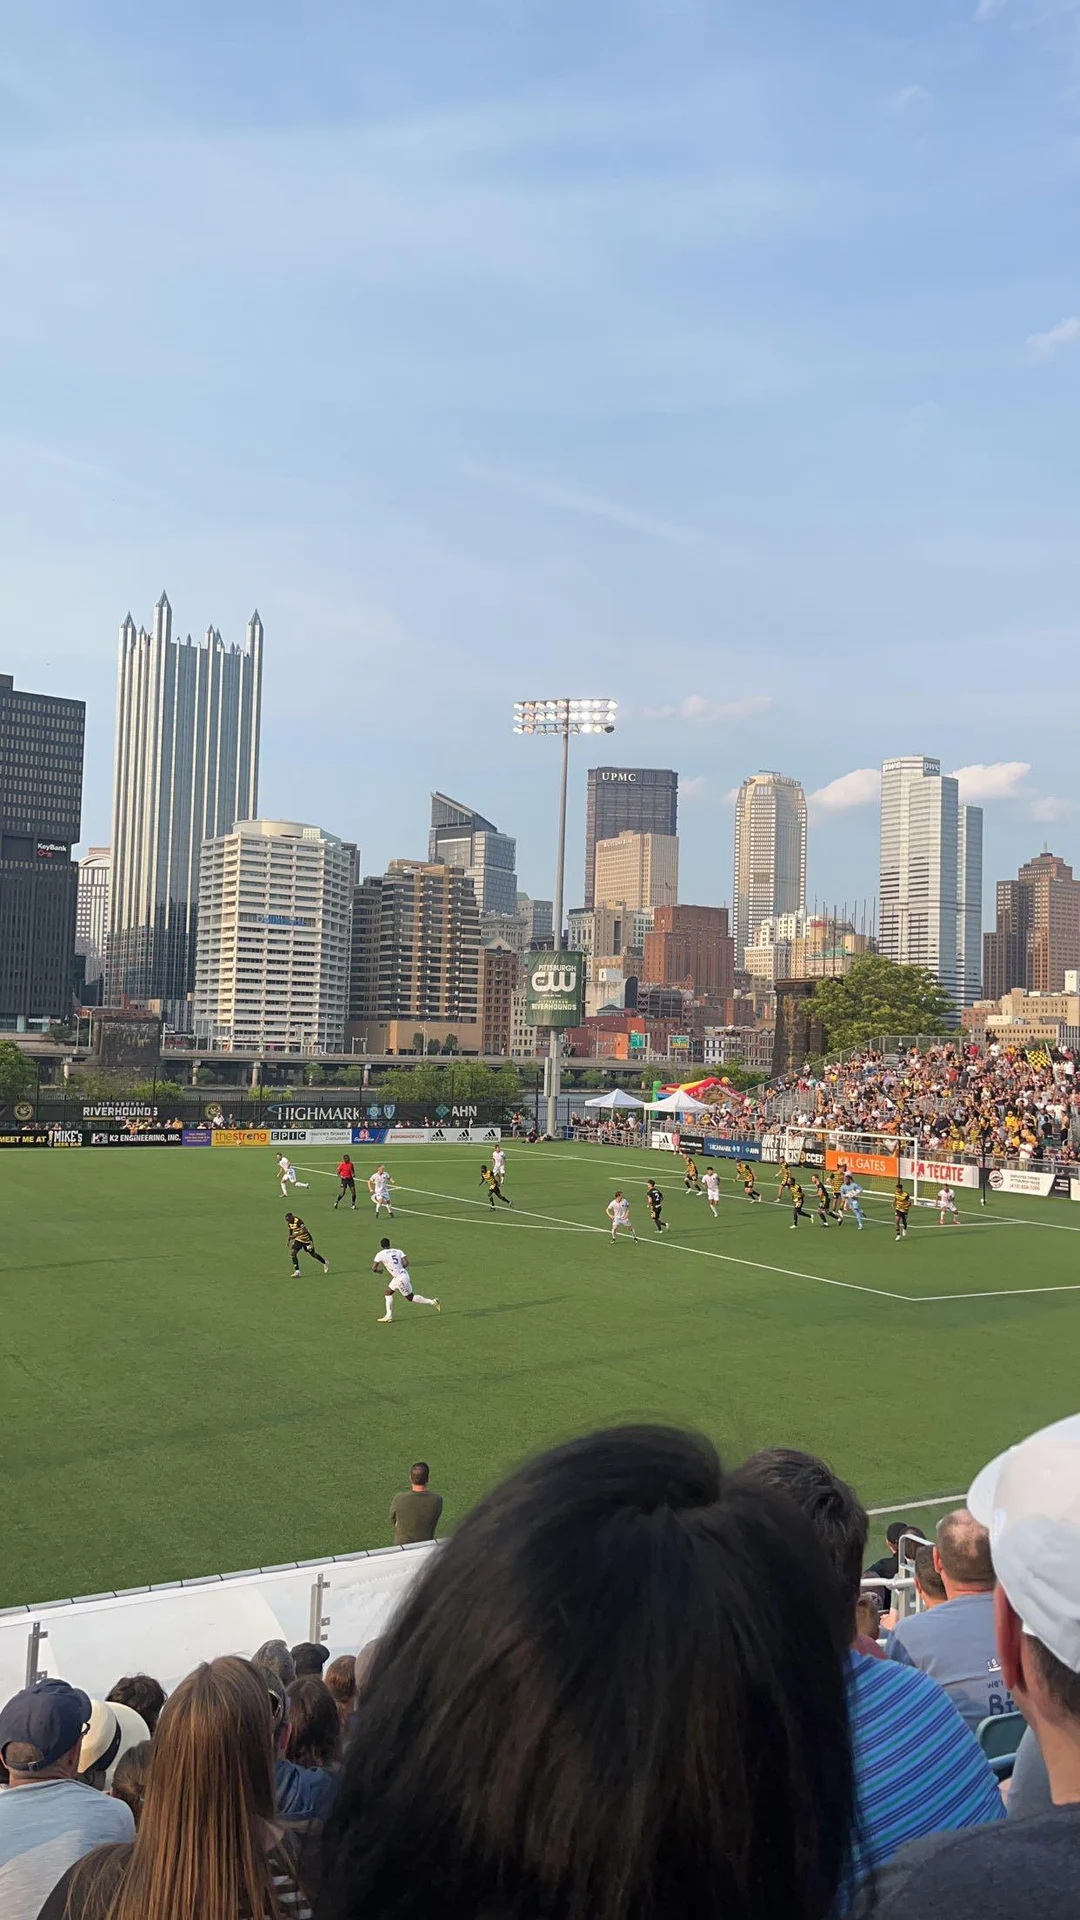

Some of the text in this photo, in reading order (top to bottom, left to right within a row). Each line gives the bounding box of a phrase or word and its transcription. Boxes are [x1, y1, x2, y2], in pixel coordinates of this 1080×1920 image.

[601, 772, 636, 782] UPMC
[37, 843, 67, 852] KeyBank
[539, 964, 577, 972] PITTSBURGH
[531, 1003, 577, 1011] RIVERHOUNDS
[278, 1106, 362, 1120] HIGHMARK
[452, 1105, 477, 1117] AHN
[0, 1135, 46, 1143] MEET ME AT
[120, 1134, 166, 1143] ENGINEERING,
[168, 1134, 181, 1142] INC.
[272, 1131, 307, 1141] EPIC
[762, 1149, 778, 1162] HATE
[856, 1158, 886, 1172] GATES
[927, 1163, 964, 1182] TECATE
[391, 1255, 399, 1265] 5
